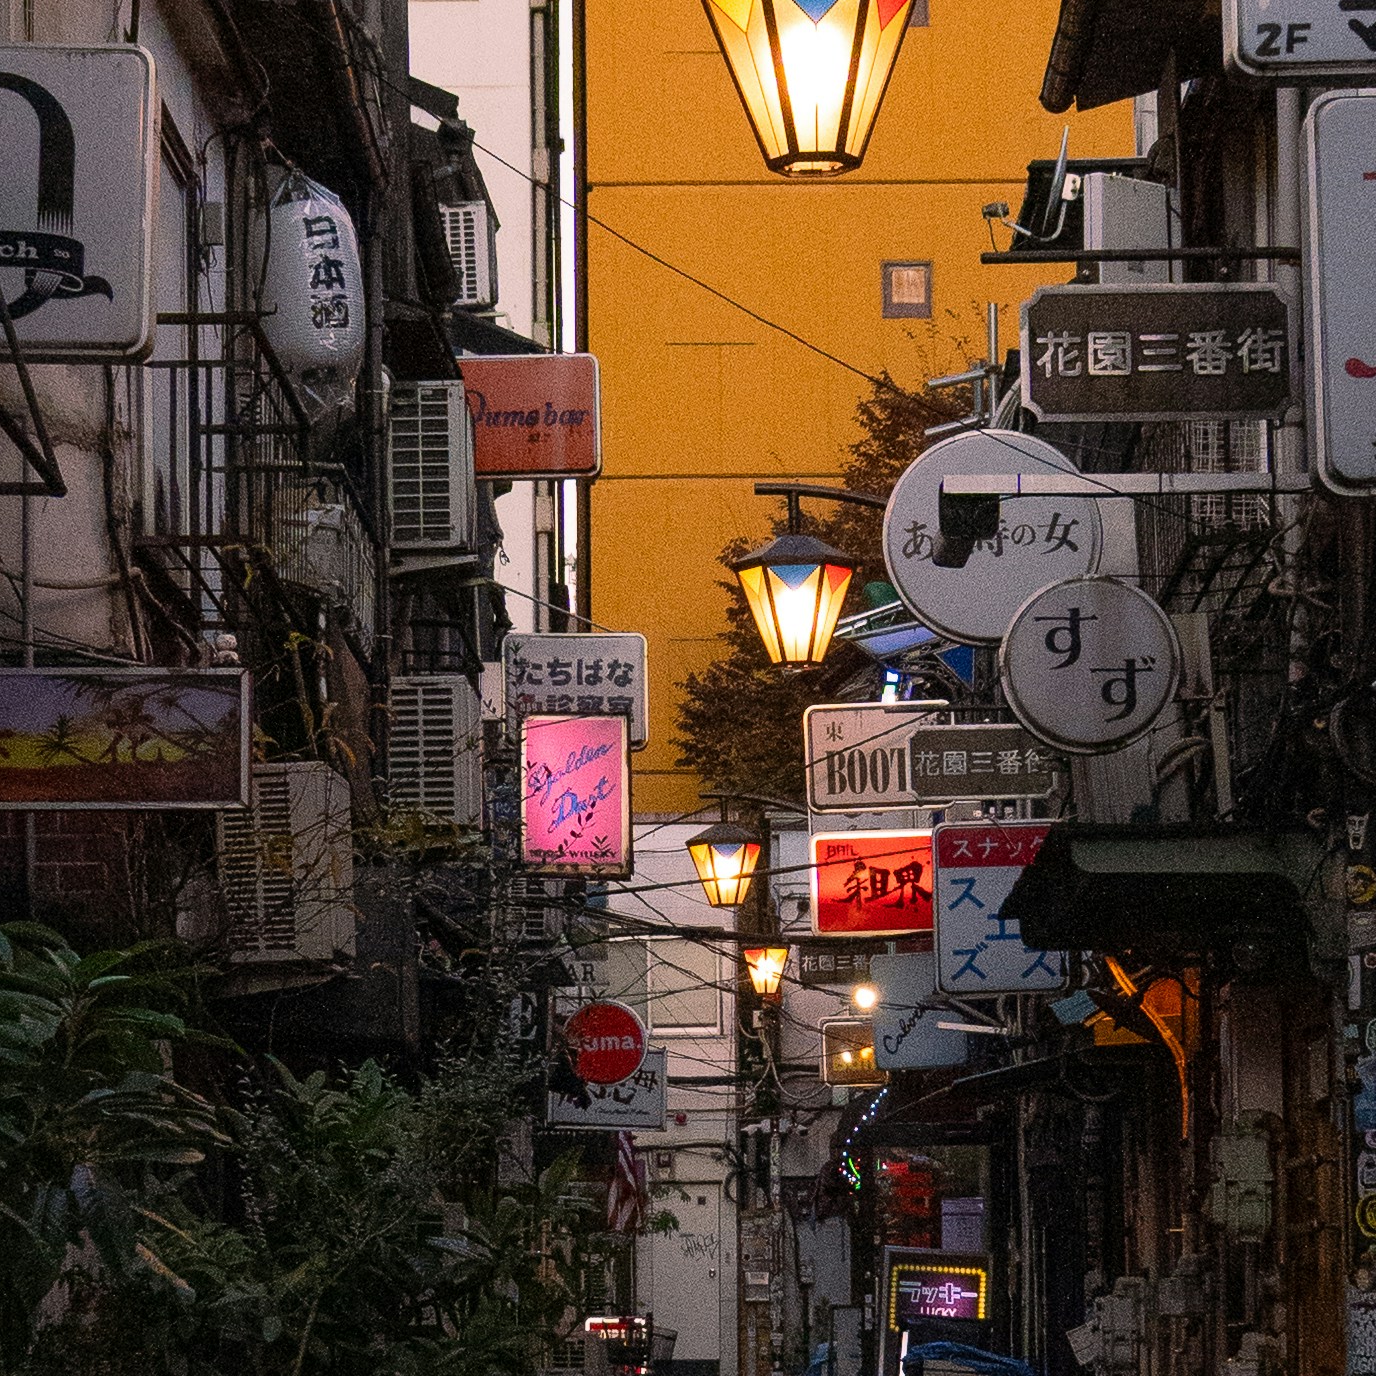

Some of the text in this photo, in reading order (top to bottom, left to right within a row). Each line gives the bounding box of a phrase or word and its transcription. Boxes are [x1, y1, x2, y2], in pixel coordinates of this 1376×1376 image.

[1256, 23, 1313, 58] 2F
[1036, 329, 1286, 379] 花園三番街
[514, 658, 635, 687] たちばな
[1034, 609, 1157, 723] すず
[898, 1281, 979, 1305] ラッキー
